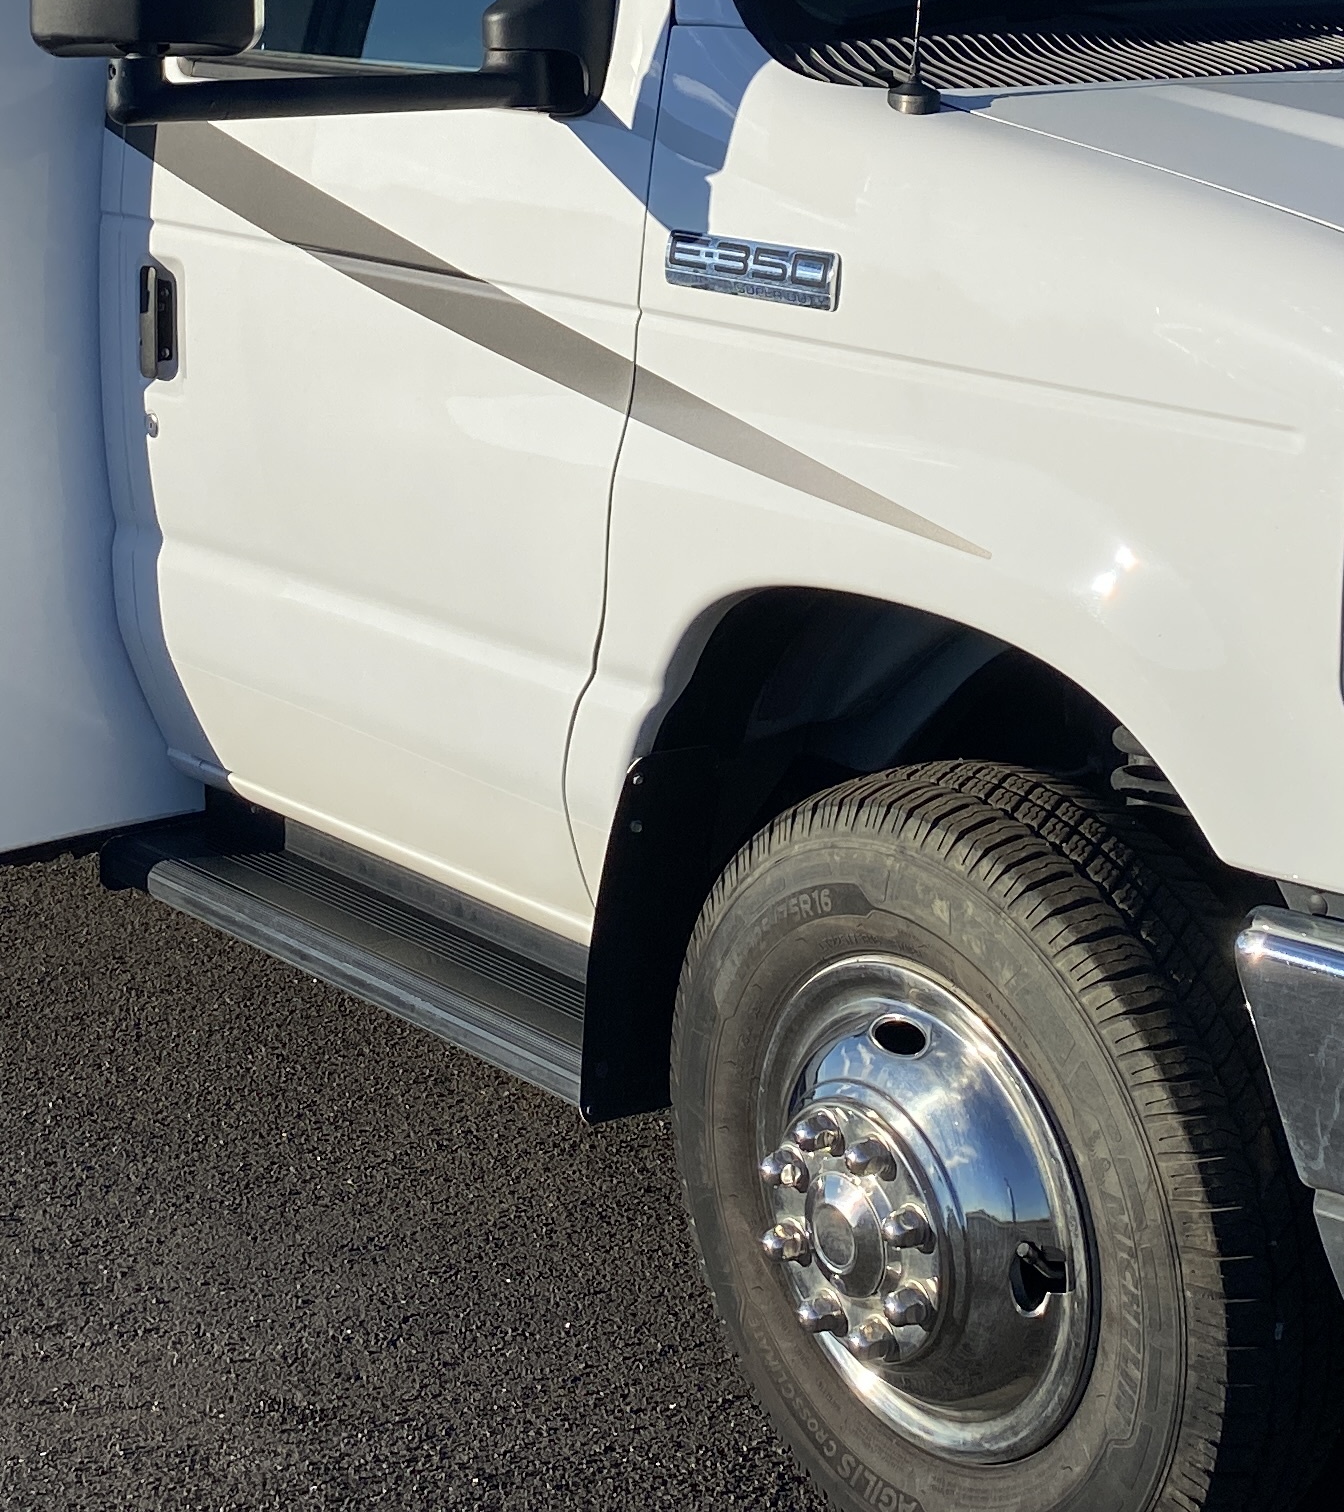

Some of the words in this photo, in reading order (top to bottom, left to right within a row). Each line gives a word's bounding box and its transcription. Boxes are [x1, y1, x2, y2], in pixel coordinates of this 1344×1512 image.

[668, 237, 831, 289] E-350
[736, 282, 781, 302] SUPER
[786, 290, 826, 306] DUTY
